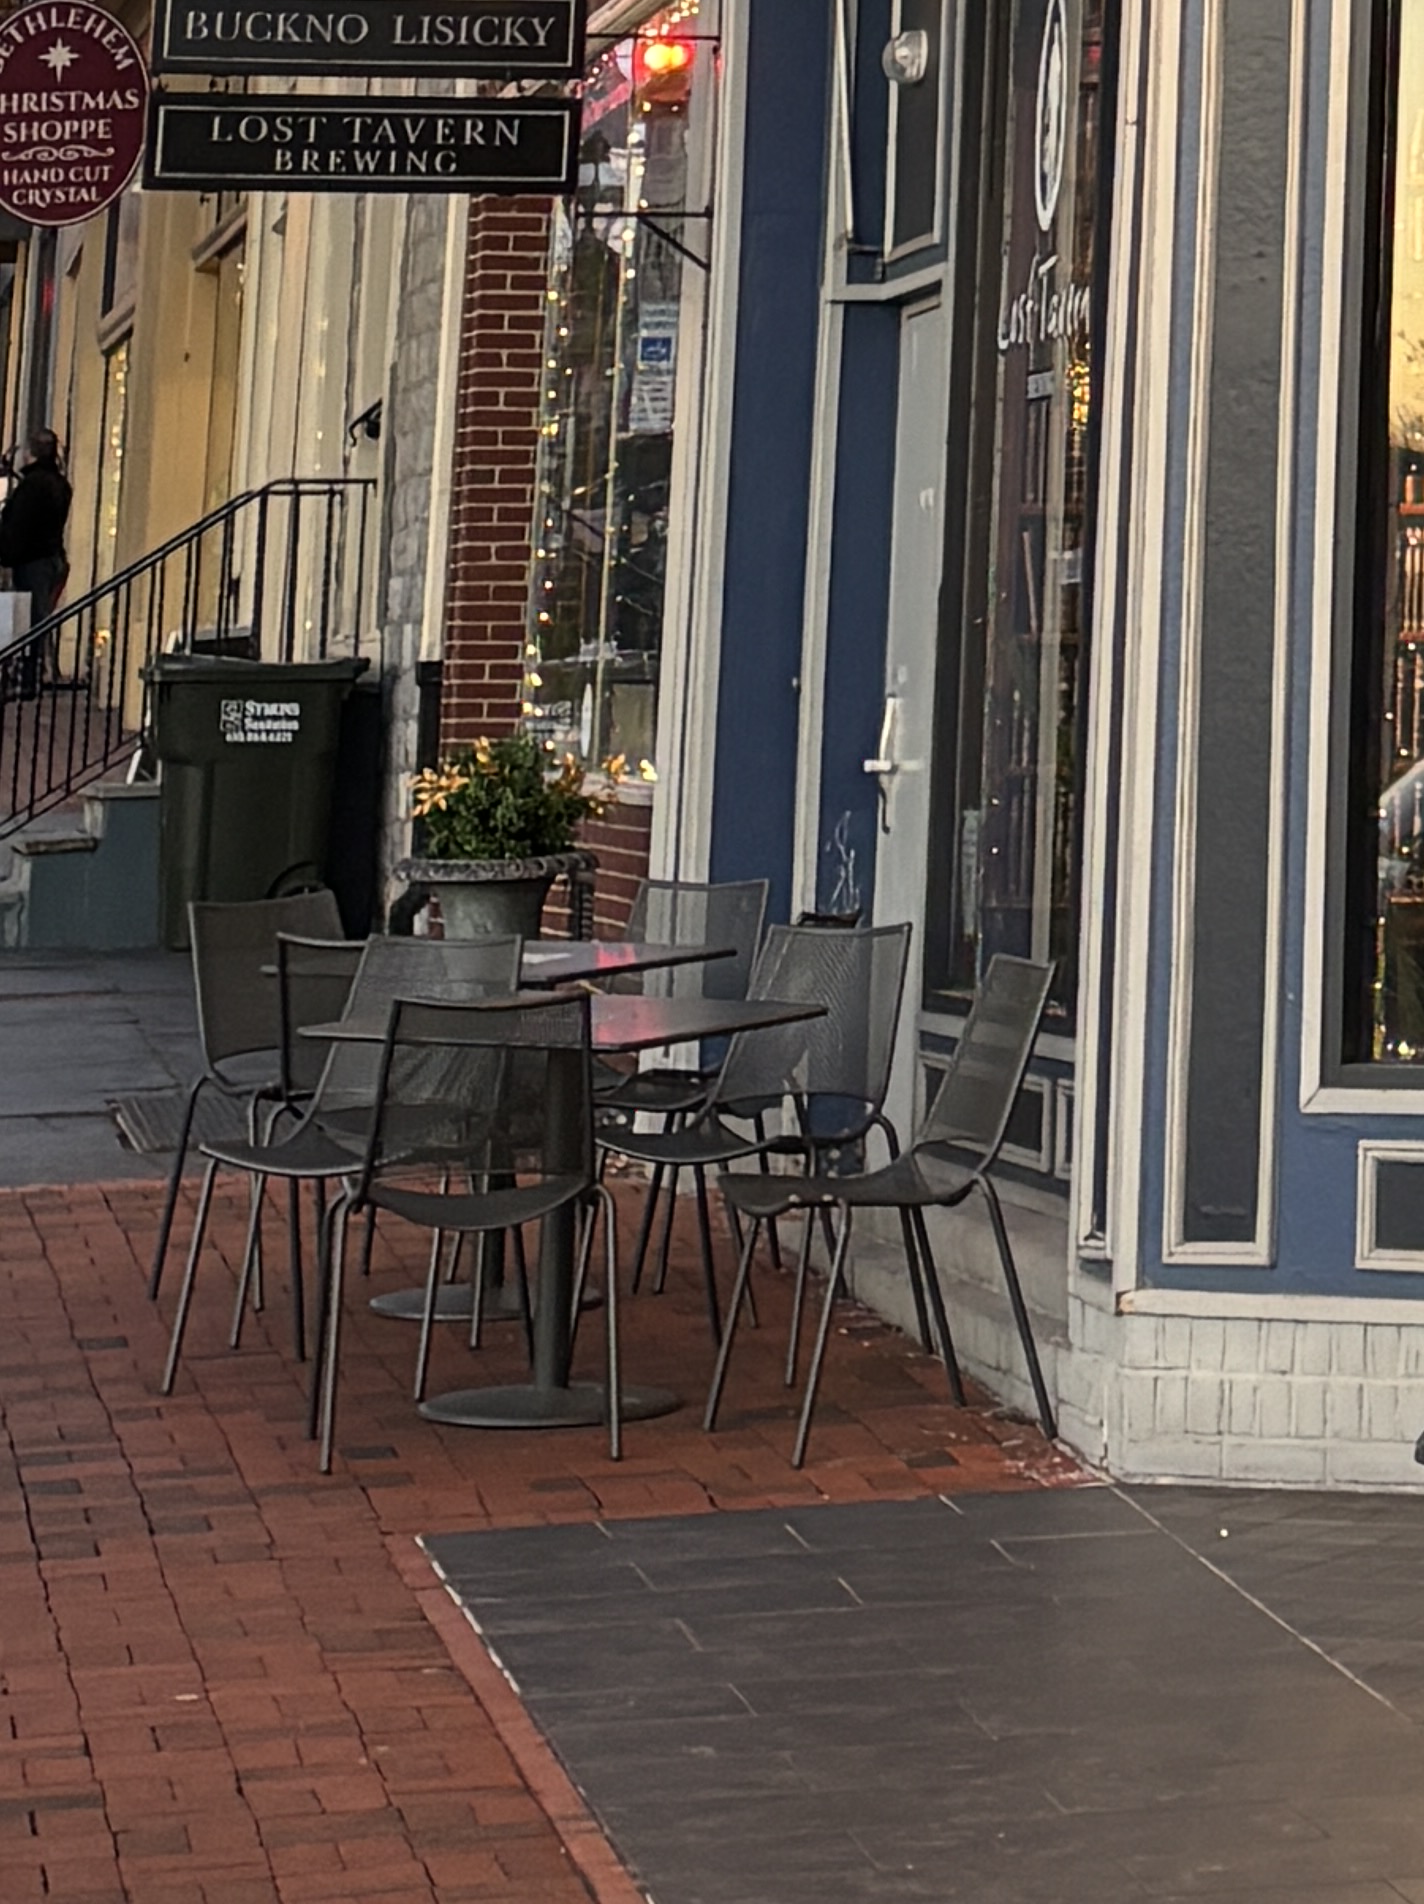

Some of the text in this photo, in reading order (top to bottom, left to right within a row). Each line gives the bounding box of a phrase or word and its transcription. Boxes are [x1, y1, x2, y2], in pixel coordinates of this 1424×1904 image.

[185, 9, 557, 48] BUCKNO LISICKY
[0, 88, 140, 114] HRISTMAS
[3, 118, 113, 143] SHOPPE
[209, 114, 522, 147] LOST TAVERN
[273, 148, 459, 175] BREWING
[3, 165, 114, 186] HAND CUT
[11, 186, 103, 209] CRYSTAL
